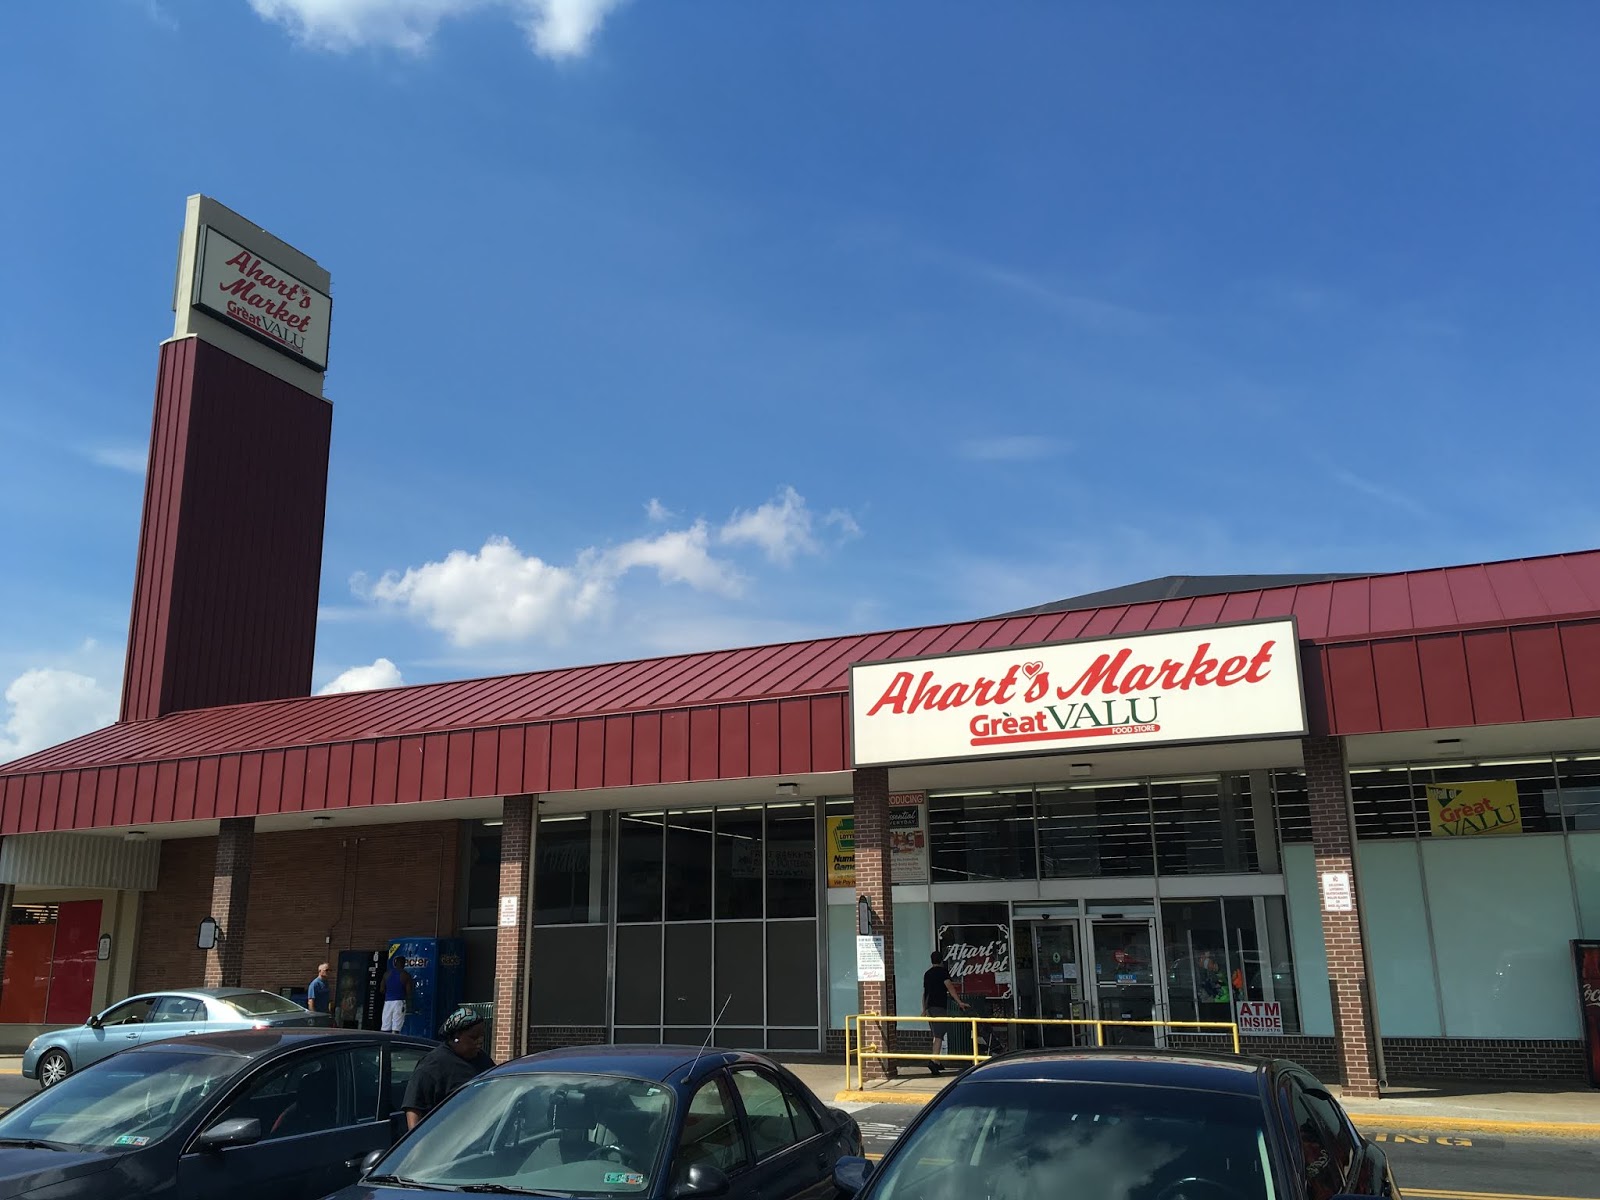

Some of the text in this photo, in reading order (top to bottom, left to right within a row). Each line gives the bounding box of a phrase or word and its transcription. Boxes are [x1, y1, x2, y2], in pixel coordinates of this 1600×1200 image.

[225, 251, 311, 308] Ahart's
[219, 278, 311, 332] Market
[261, 316, 305, 348] VALU
[866, 641, 1276, 717] Ahart's Market
[1044, 696, 1161, 729] VALU
[1134, 725, 1155, 733] STORE
[1439, 804, 1514, 835] VALU
[943, 941, 1007, 961] Ahart's
[949, 956, 1008, 978] Market
[1240, 1003, 1279, 1016] ATM
[1240, 1017, 1281, 1028] INSIDE
[1362, 1133, 1472, 1147] ING
